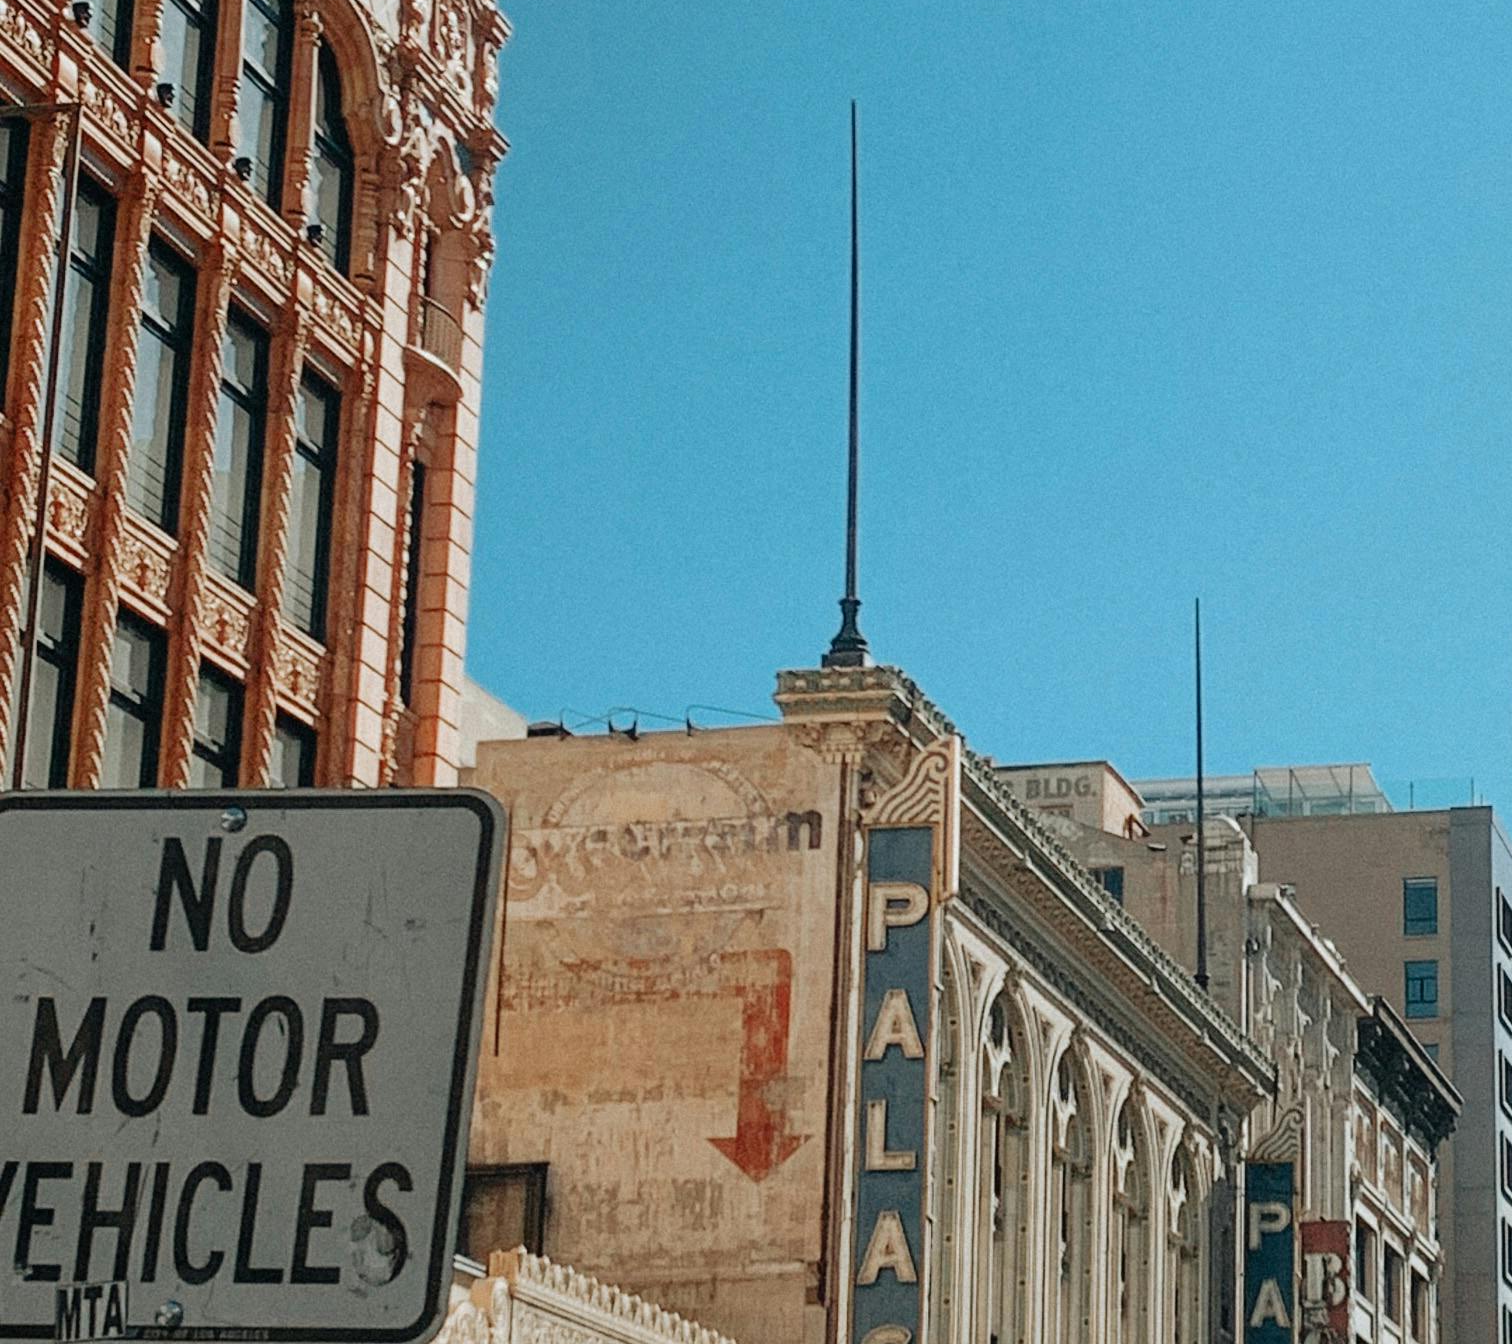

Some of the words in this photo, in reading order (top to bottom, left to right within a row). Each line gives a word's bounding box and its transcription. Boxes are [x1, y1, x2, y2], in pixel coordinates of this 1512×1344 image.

[149, 835, 294, 954] NO
[22, 994, 380, 1118] MOTOR
[57, 1285, 125, 1341] MTA
